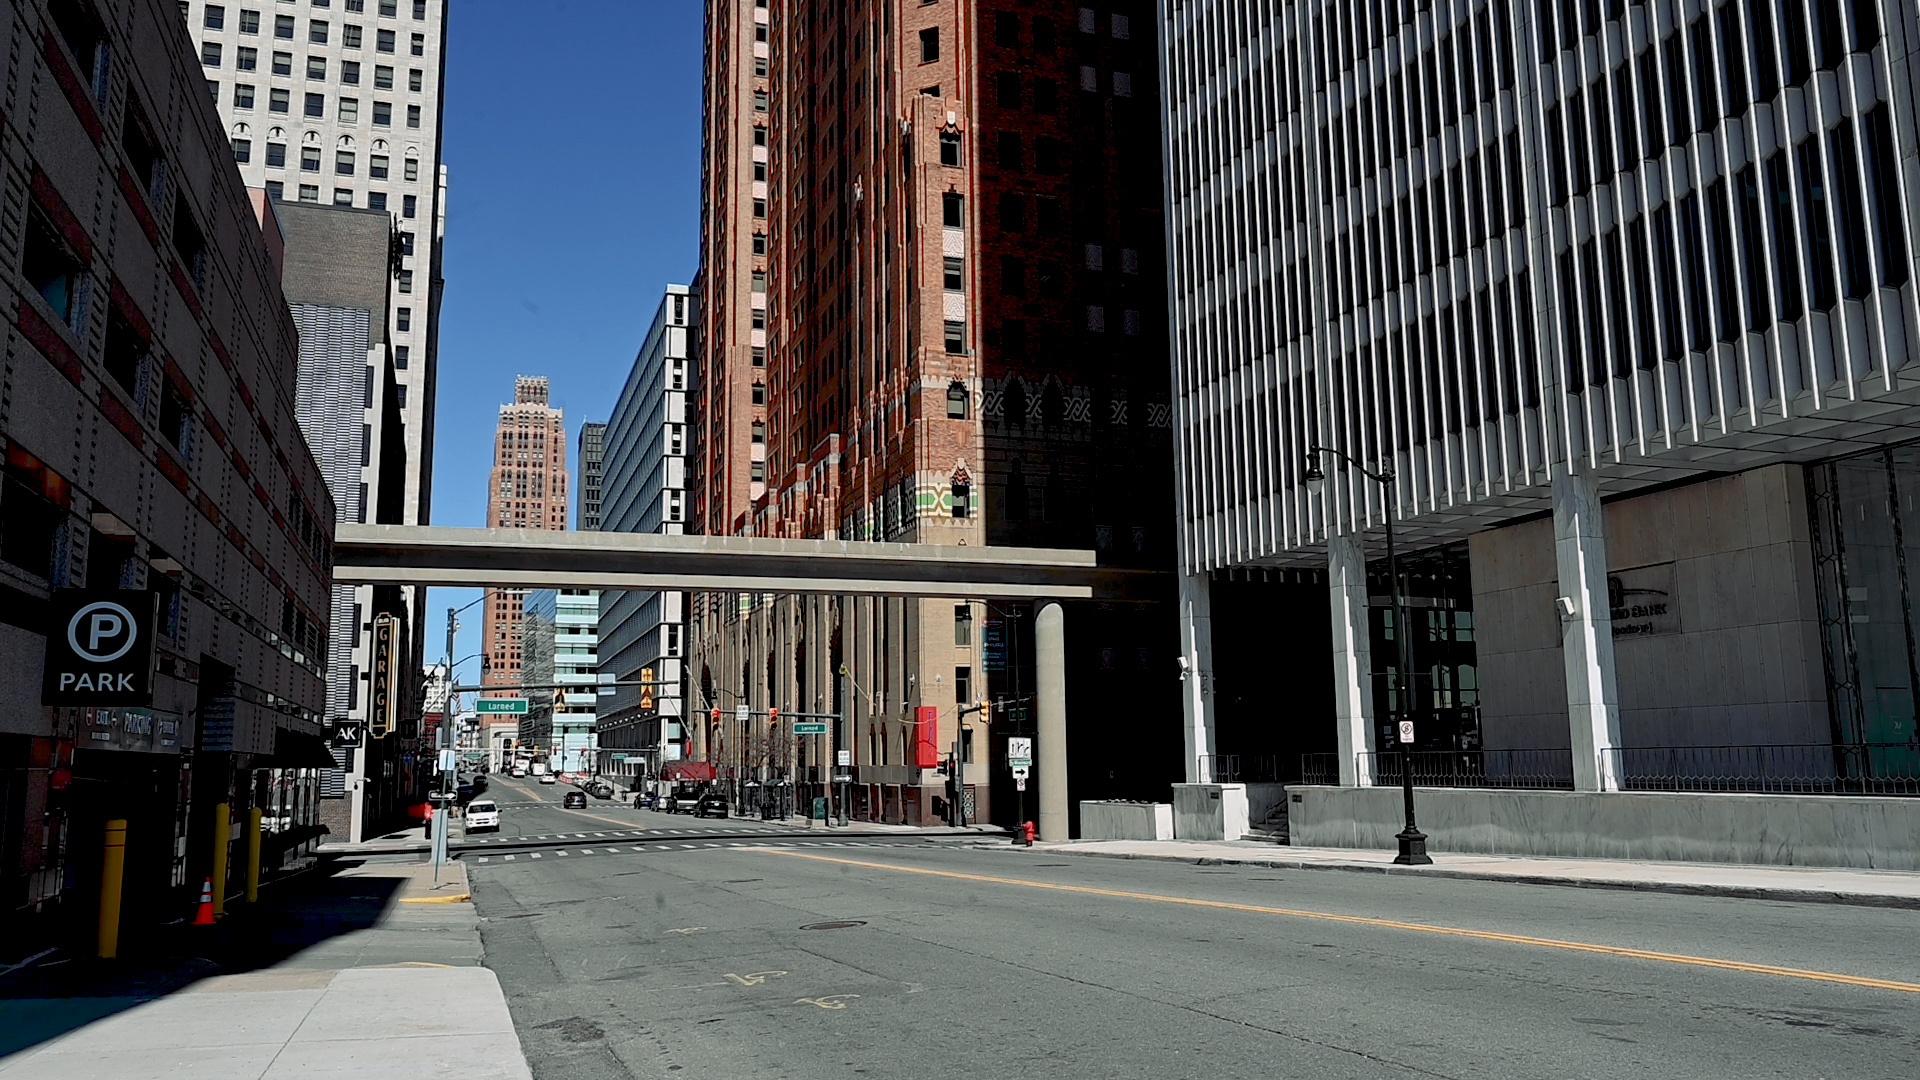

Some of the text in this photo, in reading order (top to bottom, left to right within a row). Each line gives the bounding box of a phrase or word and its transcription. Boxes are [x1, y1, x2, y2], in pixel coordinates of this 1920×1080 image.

[88, 613, 122, 650] P
[59, 672, 135, 692] PARK
[376, 627, 388, 723] GARAGE
[488, 702, 515, 711] Larned
[96, 709, 110, 725] EXIT
[124, 712, 152, 735] PARKING
[335, 726, 357, 740] AK
